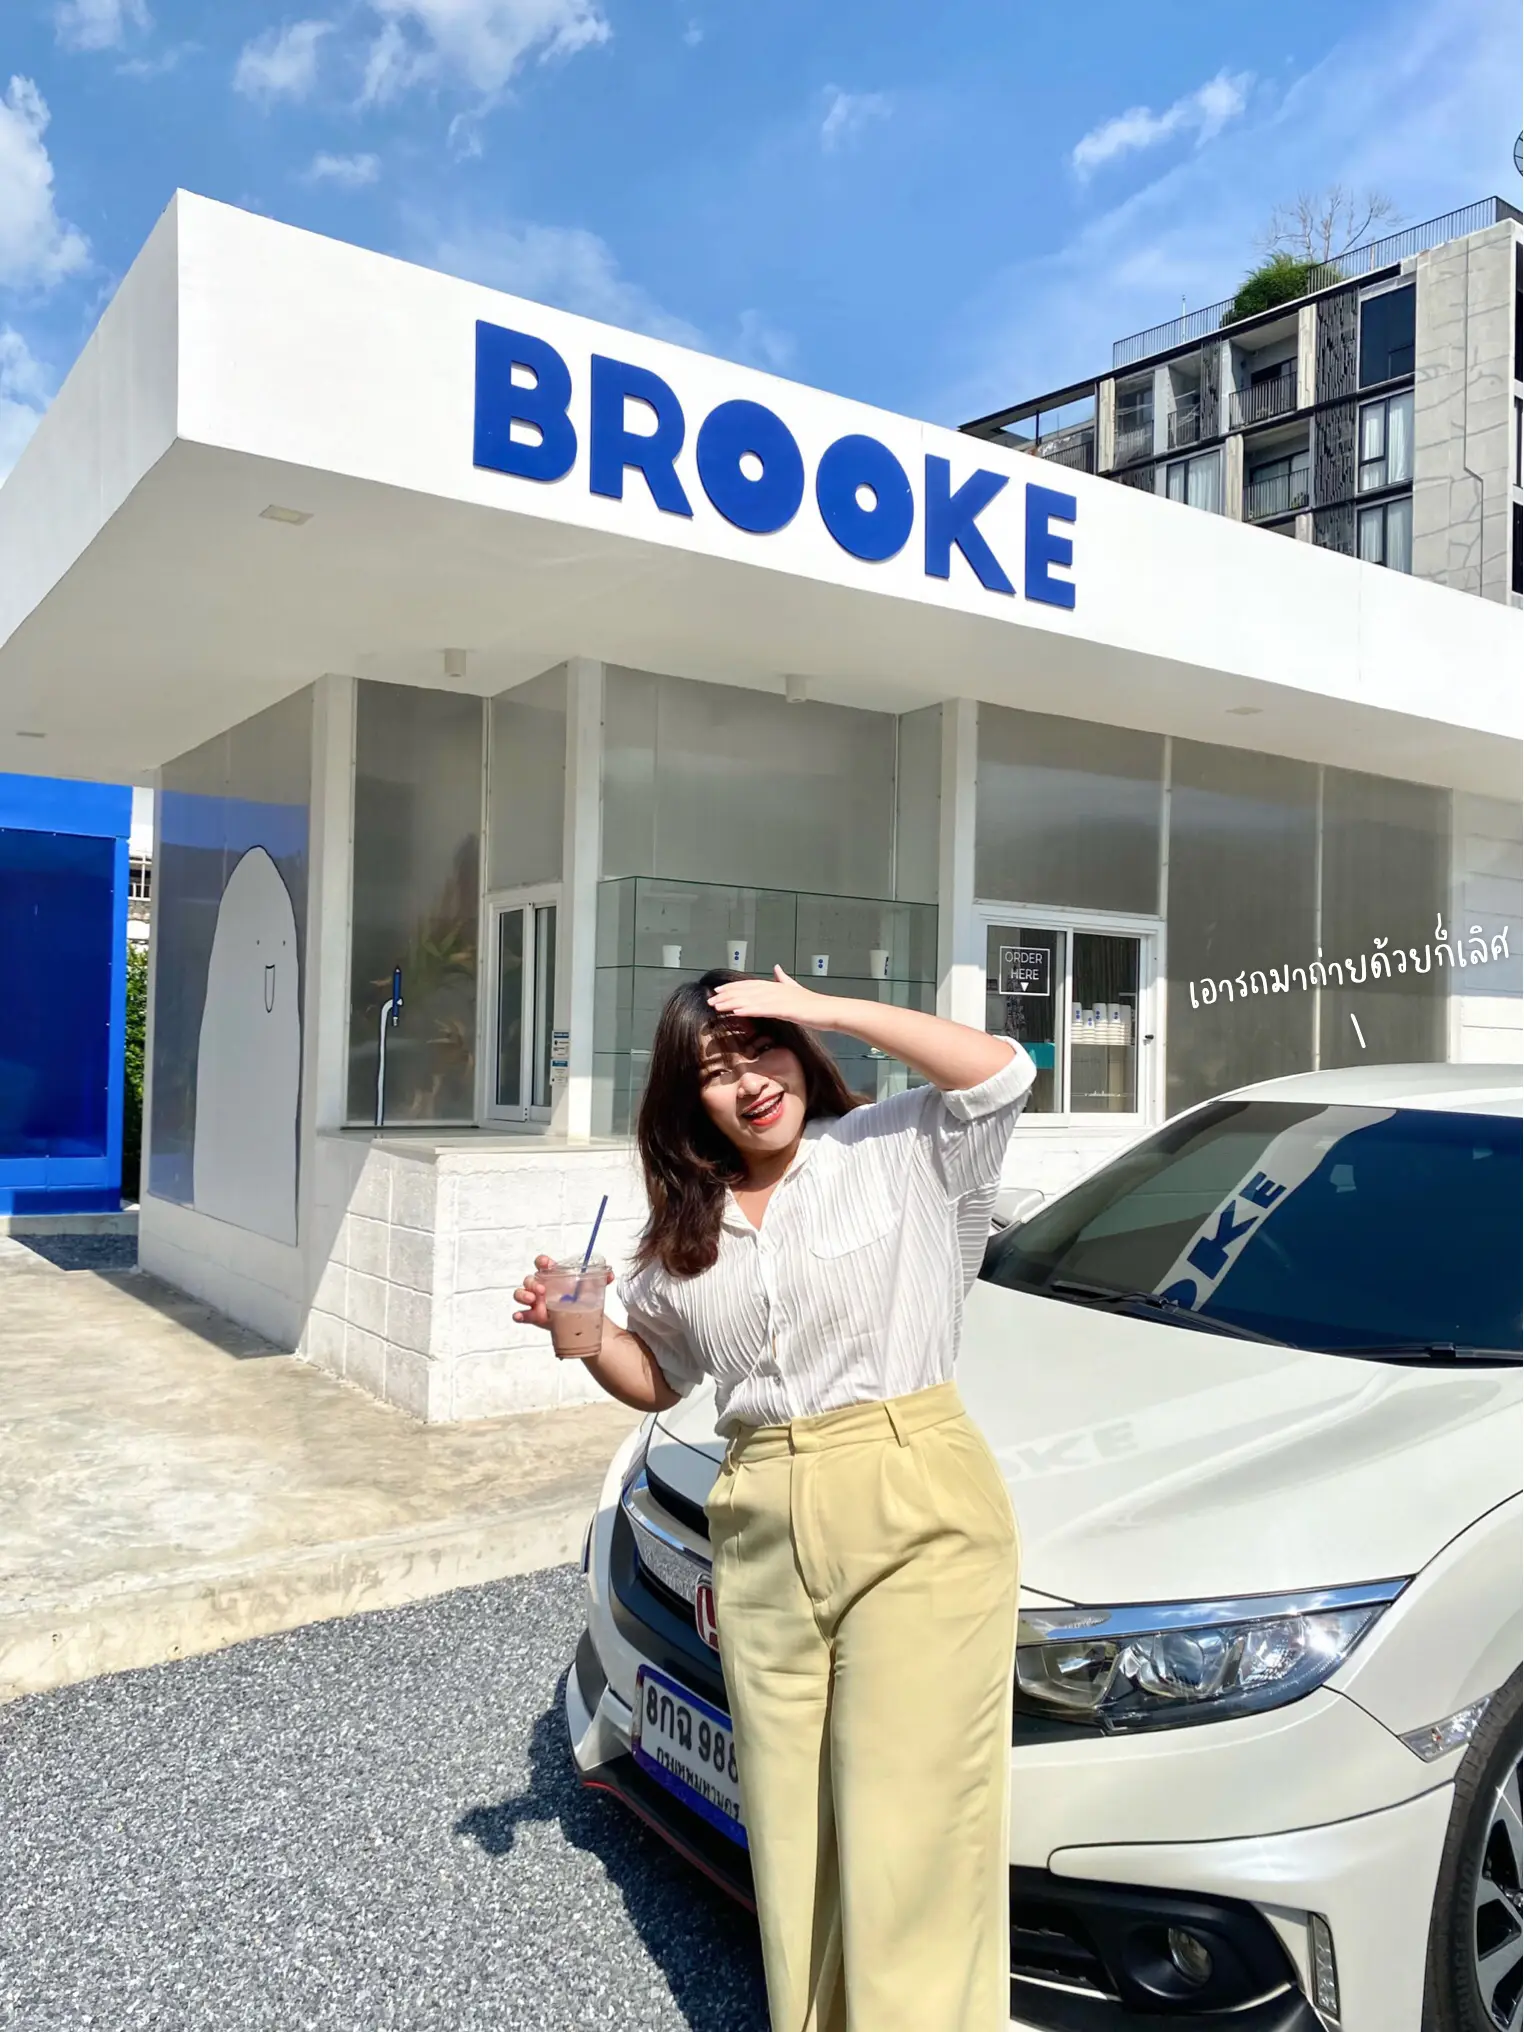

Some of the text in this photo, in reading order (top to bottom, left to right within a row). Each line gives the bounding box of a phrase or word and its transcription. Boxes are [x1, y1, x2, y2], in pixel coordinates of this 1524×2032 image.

[473, 319, 1077, 610] BROOKE
[1005, 951, 1043, 964] ORDER
[1010, 968, 1039, 981] HERE
